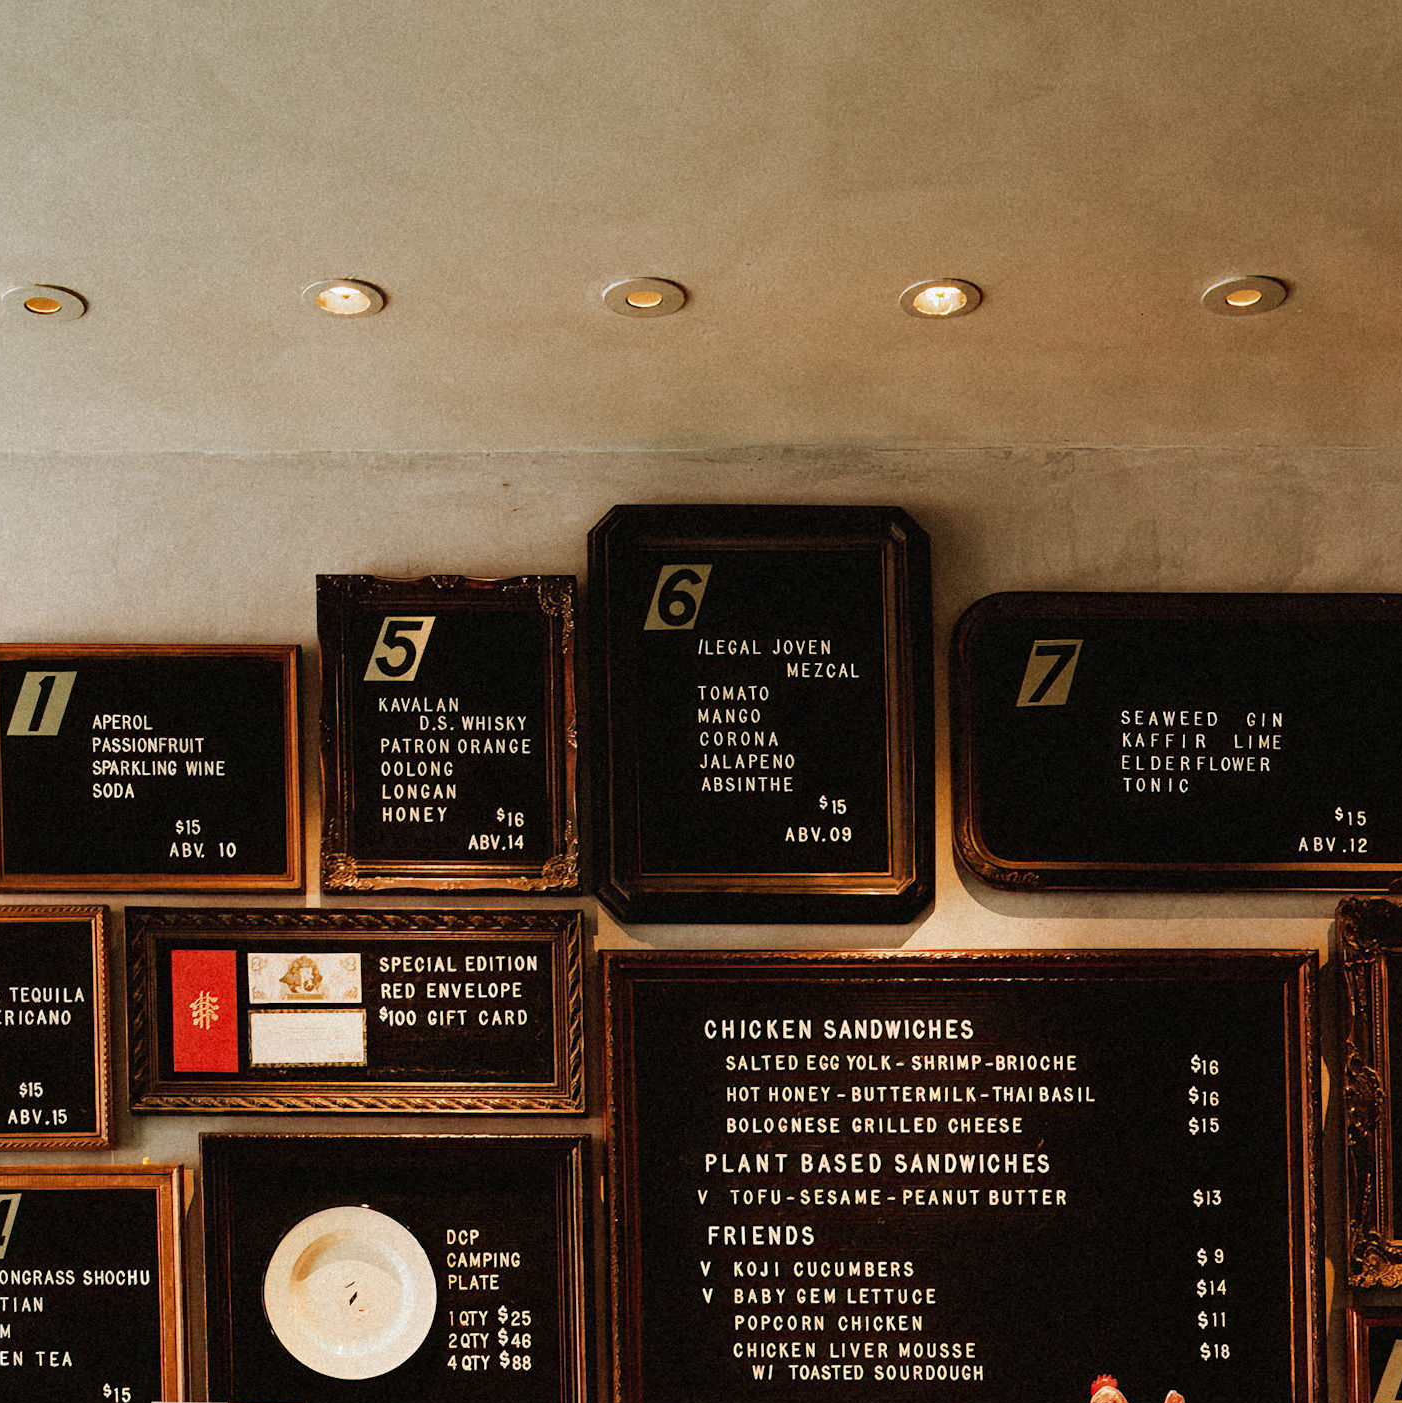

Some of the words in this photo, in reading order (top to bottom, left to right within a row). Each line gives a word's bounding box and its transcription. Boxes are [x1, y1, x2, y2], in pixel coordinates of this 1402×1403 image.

[657, 568, 702, 626] 6
[376, 621, 421, 677] 5
[773, 639, 830, 655] JOVEN
[787, 663, 859, 678] MEZCAL
[1027, 643, 1076, 703] 7
[698, 686, 768, 701] TOMATO
[29, 676, 55, 732] 1
[379, 697, 458, 712] KAVALAN
[93, 714, 152, 730] APEROL
[420, 716, 454, 731] D.S.
[462, 716, 526, 731] WHISKY
[698, 709, 760, 723] MANGO
[1121, 711, 1217, 726] SEAWEED
[1247, 712, 1282, 727] GIN
[93, 737, 204, 753] PASSIONFRUIT
[381, 738, 449, 754] PATRON
[458, 739, 530, 754] ORANGE
[700, 732, 778, 746] CORONA
[1123, 733, 1205, 748] KAFFIR
[1235, 734, 1281, 749] LIME
[93, 760, 177, 775] SPARKLING
[186, 761, 225, 776] WINE
[381, 761, 452, 776] OOLONG
[700, 754, 794, 769] JALAPENO
[1122, 755, 1270, 771] ELDERFLOWER
[93, 783, 134, 798] SODA
[383, 784, 456, 799] LONGAN
[702, 777, 793, 792] ABSINTHE
[1123, 778, 1188, 793] TONIC
[383, 807, 447, 822] HONEY
[176, 820, 200, 835] $15
[380, 956, 457, 972] SPECIAL
[465, 956, 537, 971] EDITION
[9, 987, 84, 1003] TEQUILA
[381, 983, 415, 999] RED
[427, 982, 521, 998] ENVELOPE
[379, 1006, 416, 1026] $100
[428, 1010, 467, 1025] GIFT
[479, 1010, 527, 1025] CARD
[705, 1020, 811, 1039] CHICKEN
[824, 1019, 973, 1039] SANDWICHES
[726, 1055, 798, 1071] SALTED
[807, 1055, 839, 1071] EGG
[1191, 1055, 1219, 1075] $16
[19, 1082, 43, 1098] $15
[727, 1087, 760, 1102] HOT
[1039, 1087, 1095, 1102] BASIL
[1189, 1086, 1219, 1106] $16
[727, 1117, 840, 1133] BOLOGNESE
[852, 1117, 937, 1133] GRILLED
[948, 1117, 1022, 1133] CHEESE
[1189, 1117, 1219, 1135] $15
[705, 1154, 787, 1173] PLANT
[801, 1153, 881, 1173] BASED
[895, 1153, 1049, 1173] SANDWICHES
[989, 1189, 1066, 1205] BUTTER
[1193, 1189, 1221, 1207] $13
[447, 1229, 479, 1245] DCP
[709, 1226, 814, 1245] FRIENDS
[447, 1252, 520, 1268] CAMPING
[734, 1261, 778, 1277] KOJI
[794, 1261, 914, 1277] CUCUMBERS
[83, 1270, 150, 1285] SHOCHU
[448, 1274, 499, 1290] PLATE
[734, 1288, 785, 1304] BABY
[797, 1288, 835, 1304] GEM
[848, 1288, 935, 1304] LETTUCE
[1197, 1279, 1226, 1297] $14
[735, 1315, 824, 1331] POPCORN
[838, 1316, 922, 1331] CHICKEN
[1198, 1311, 1225, 1329] $11
[36, 1351, 72, 1367] TEA
[733, 1342, 815, 1358] CHICKEN
[830, 1343, 887, 1358] LIVER
[899, 1343, 975, 1358] MOUSSE
[1200, 1342, 1230, 1361] $18
[789, 1365, 863, 1380] TOASTED
[875, 1365, 983, 1381] SOURDOUGH
